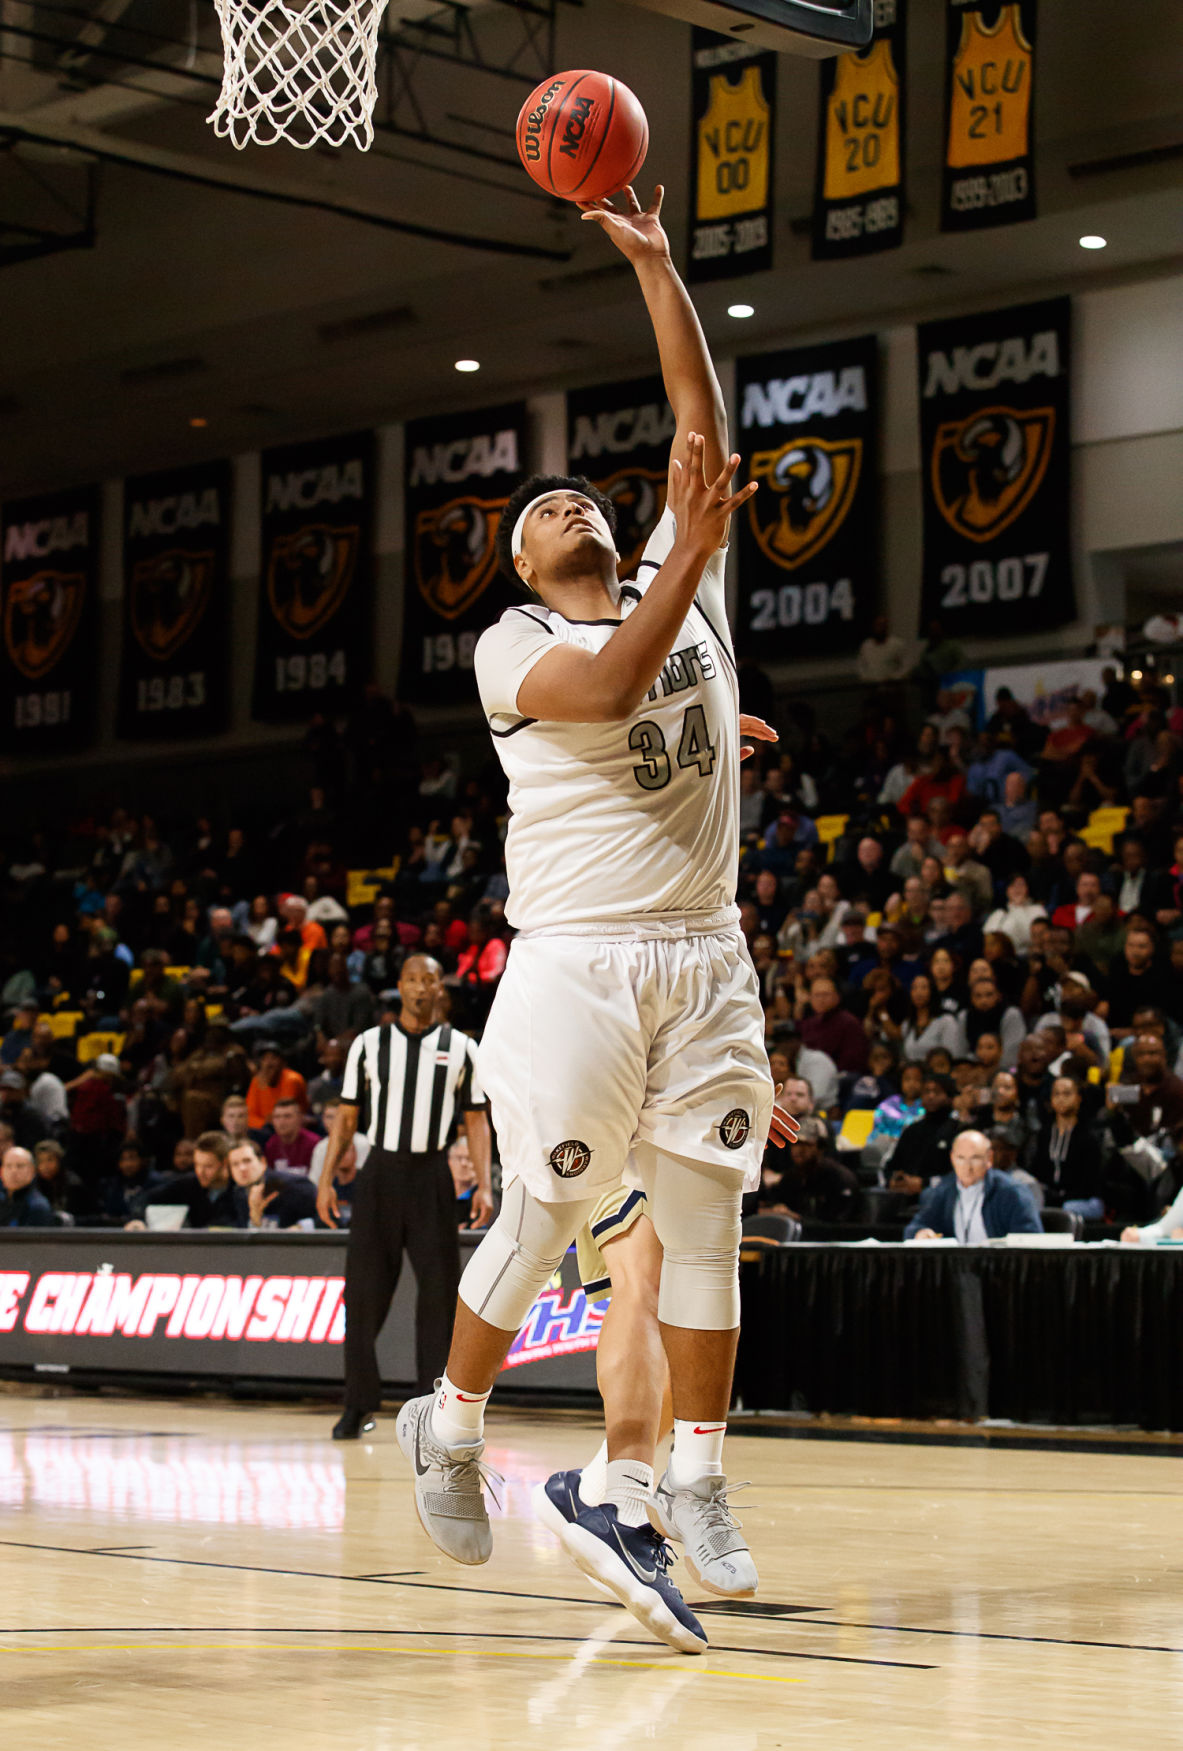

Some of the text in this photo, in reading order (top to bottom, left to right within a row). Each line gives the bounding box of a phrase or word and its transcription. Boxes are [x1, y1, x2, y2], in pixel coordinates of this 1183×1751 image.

[957, 59, 1026, 100] VCU
[525, 80, 567, 161] Wilson
[560, 97, 595, 159] NCAA
[705, 118, 765, 158] VCU
[834, 93, 895, 134] VCU
[968, 102, 1003, 139] 21
[716, 158, 749, 194] 00
[844, 134, 881, 173] 20
[924, 330, 1060, 397] NCAA
[742, 365, 867, 429] NCAA
[409, 428, 519, 488] NCAA
[265, 460, 364, 514] NCAA
[3, 510, 89, 563] NCAA
[129, 488, 220, 540] NCAA
[750, 578, 854, 631] 2004
[941, 552, 1050, 608] 2007
[136, 671, 208, 713] 1983
[273, 649, 348, 693] 1984
[628, 703, 716, 791] 34
